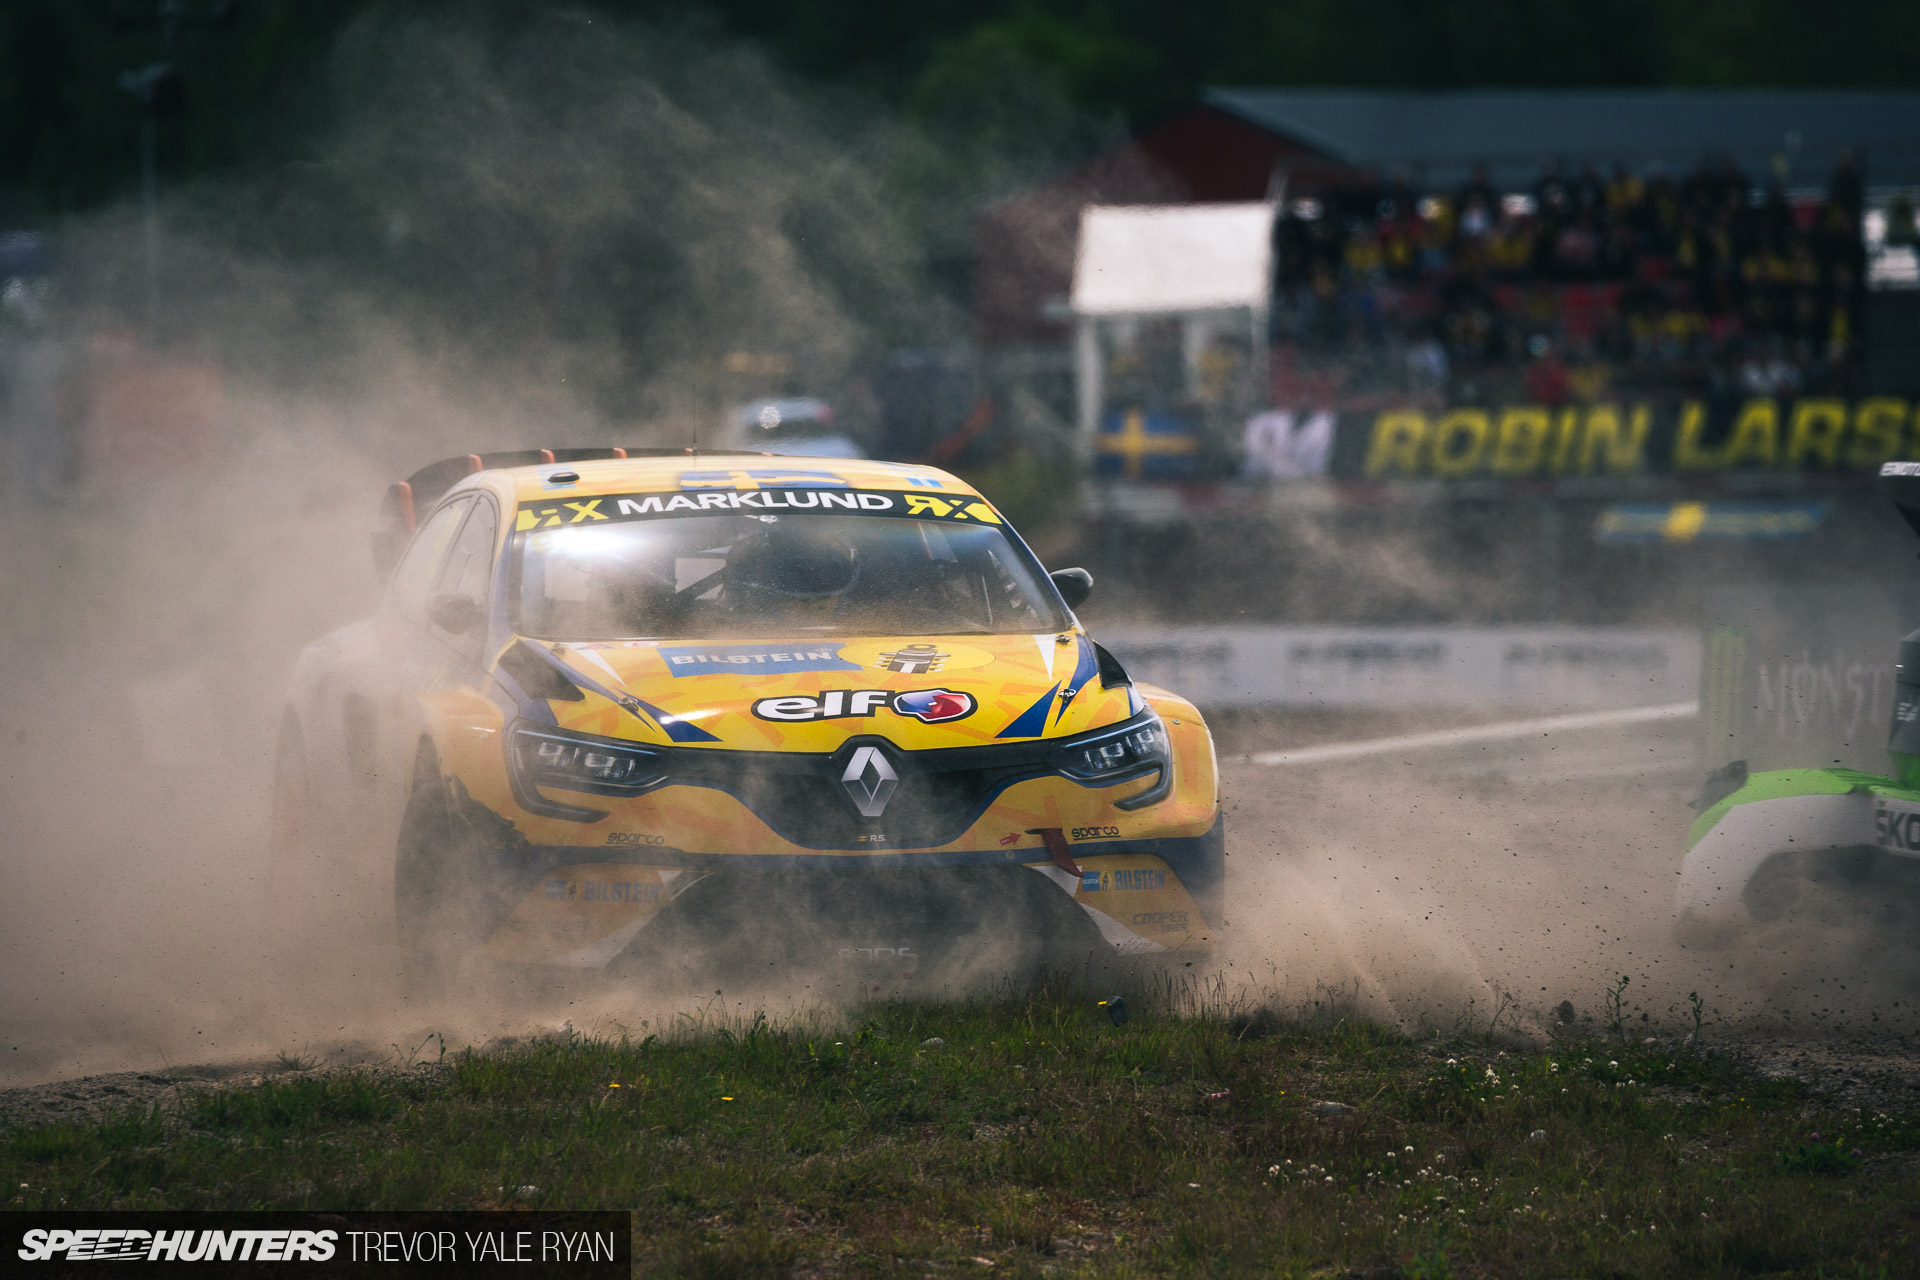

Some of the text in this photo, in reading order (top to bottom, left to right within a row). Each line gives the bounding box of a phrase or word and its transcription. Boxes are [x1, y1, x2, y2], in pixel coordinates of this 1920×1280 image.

[1364, 404, 1652, 478] ROBIN
[1671, 399, 1920, 471] LARS
[617, 492, 893, 516] MARKLUND
[671, 651, 834, 665] BILSTEIN
[755, 690, 889, 721] elf
[607, 832, 665, 846] sparco
[1071, 826, 1120, 841] sparco
[1114, 869, 1165, 890] BILSTEIN
[584, 880, 660, 903] BILSTEIN
